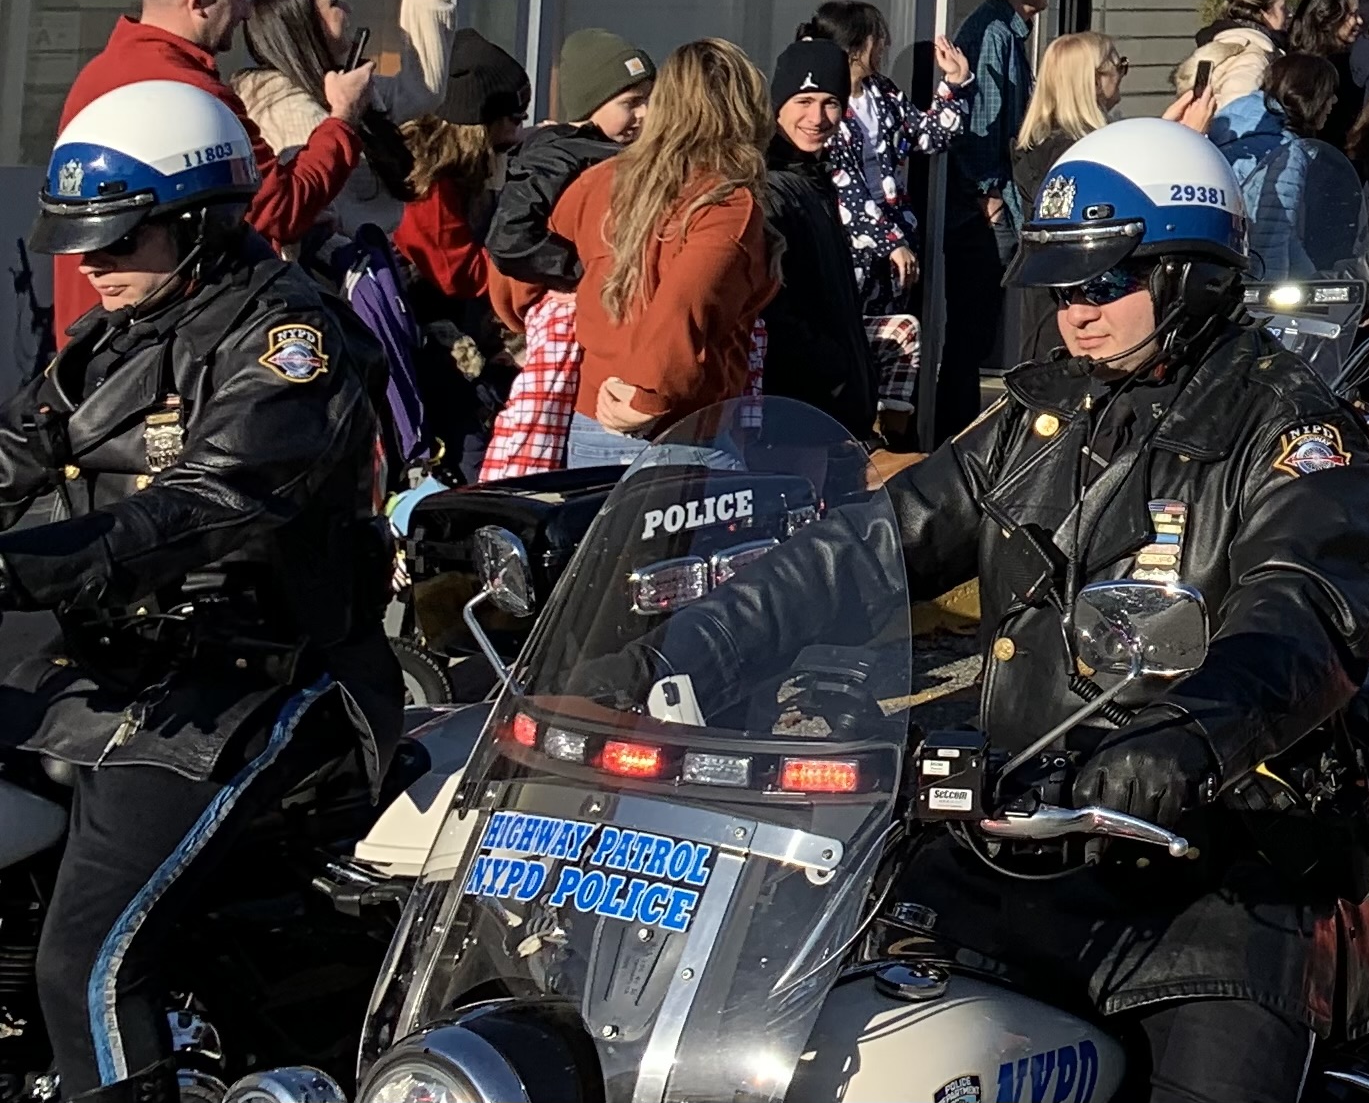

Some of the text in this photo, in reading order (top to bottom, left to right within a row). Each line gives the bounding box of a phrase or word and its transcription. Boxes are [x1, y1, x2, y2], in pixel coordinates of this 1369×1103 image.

[182, 141, 234, 168] 11803
[1170, 184, 1227, 207] 29381
[277, 328, 316, 343] NYPD
[1289, 424, 1334, 440] NYPD
[641, 489, 753, 540] POLICE
[483, 811, 713, 886] HIGHWAY PATROL
[465, 855, 699, 933] NYPD POLICE
[996, 1039, 1099, 1103] NYPD
[944, 1076, 972, 1095] POLICE
